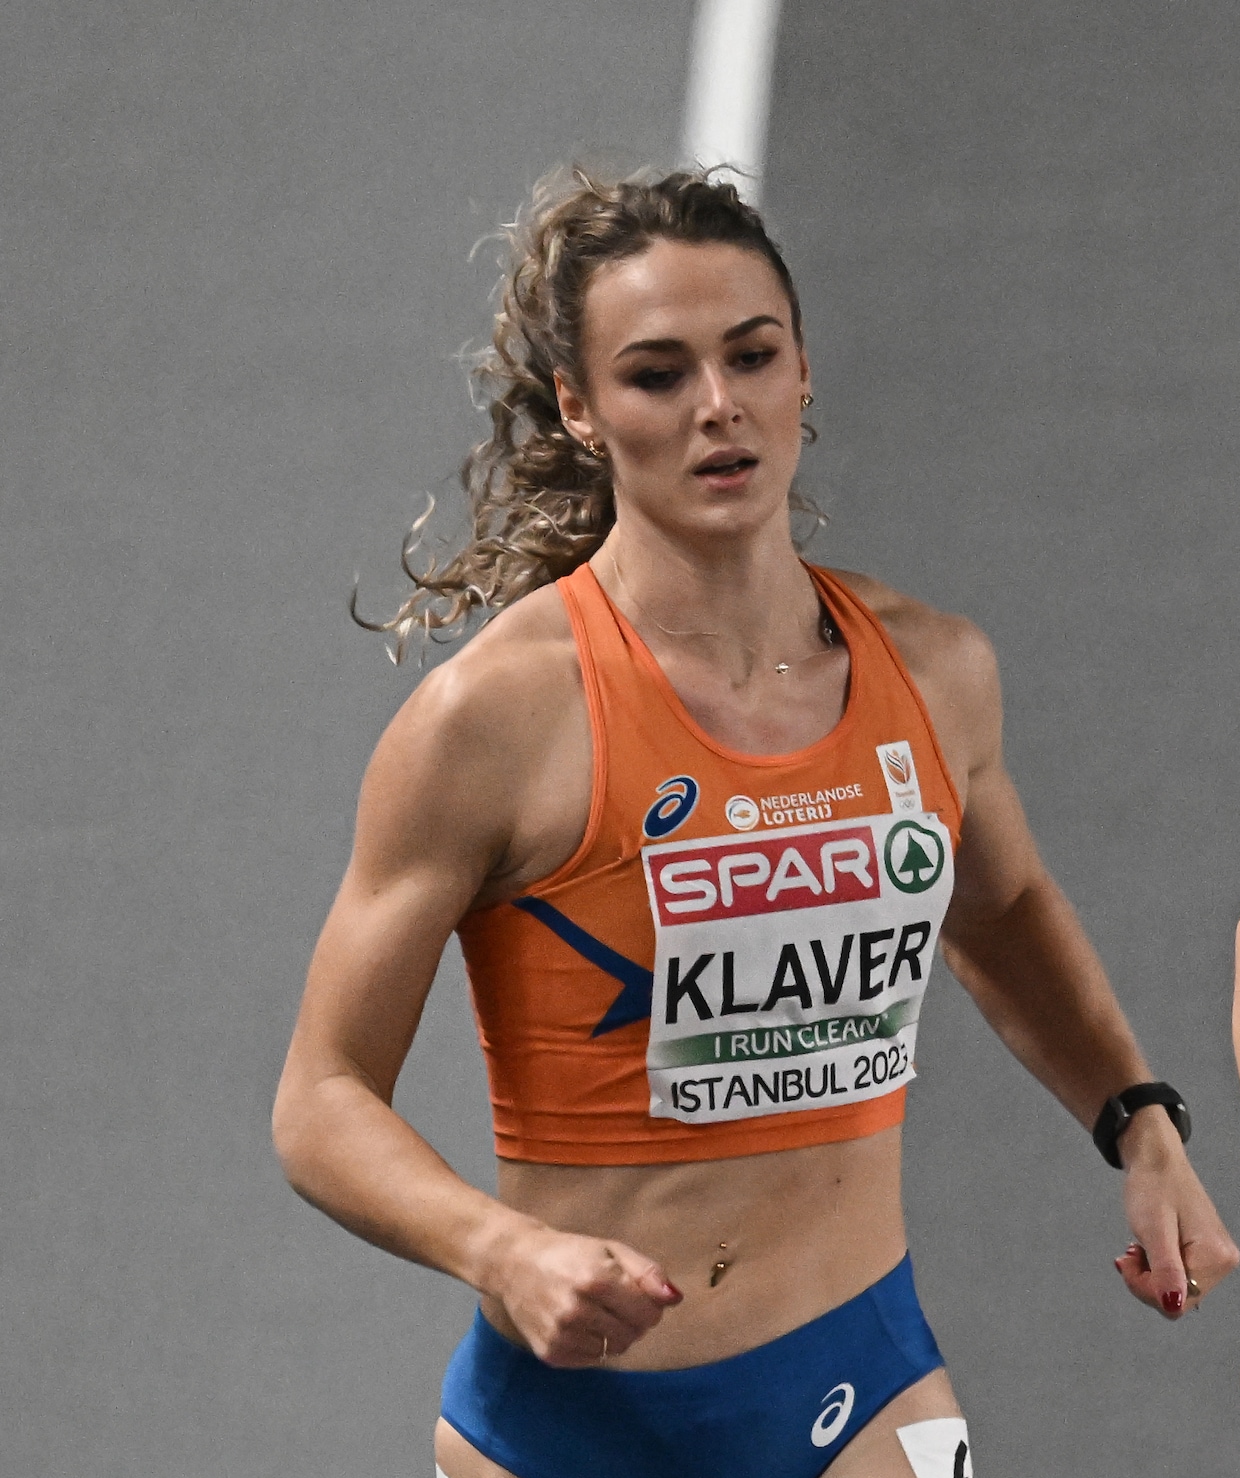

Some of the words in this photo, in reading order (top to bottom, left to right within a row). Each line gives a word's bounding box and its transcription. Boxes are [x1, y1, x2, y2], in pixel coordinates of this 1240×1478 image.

[760, 783, 863, 811] NEDERLANDSE
[763, 804, 832, 826] LOTERIJ
[660, 838, 874, 914] SPAR
[665, 920, 931, 1025] KLAVER
[715, 1037, 722, 1058] I
[731, 1026, 793, 1057] RUN
[672, 1063, 848, 1113] ISTANBUL
